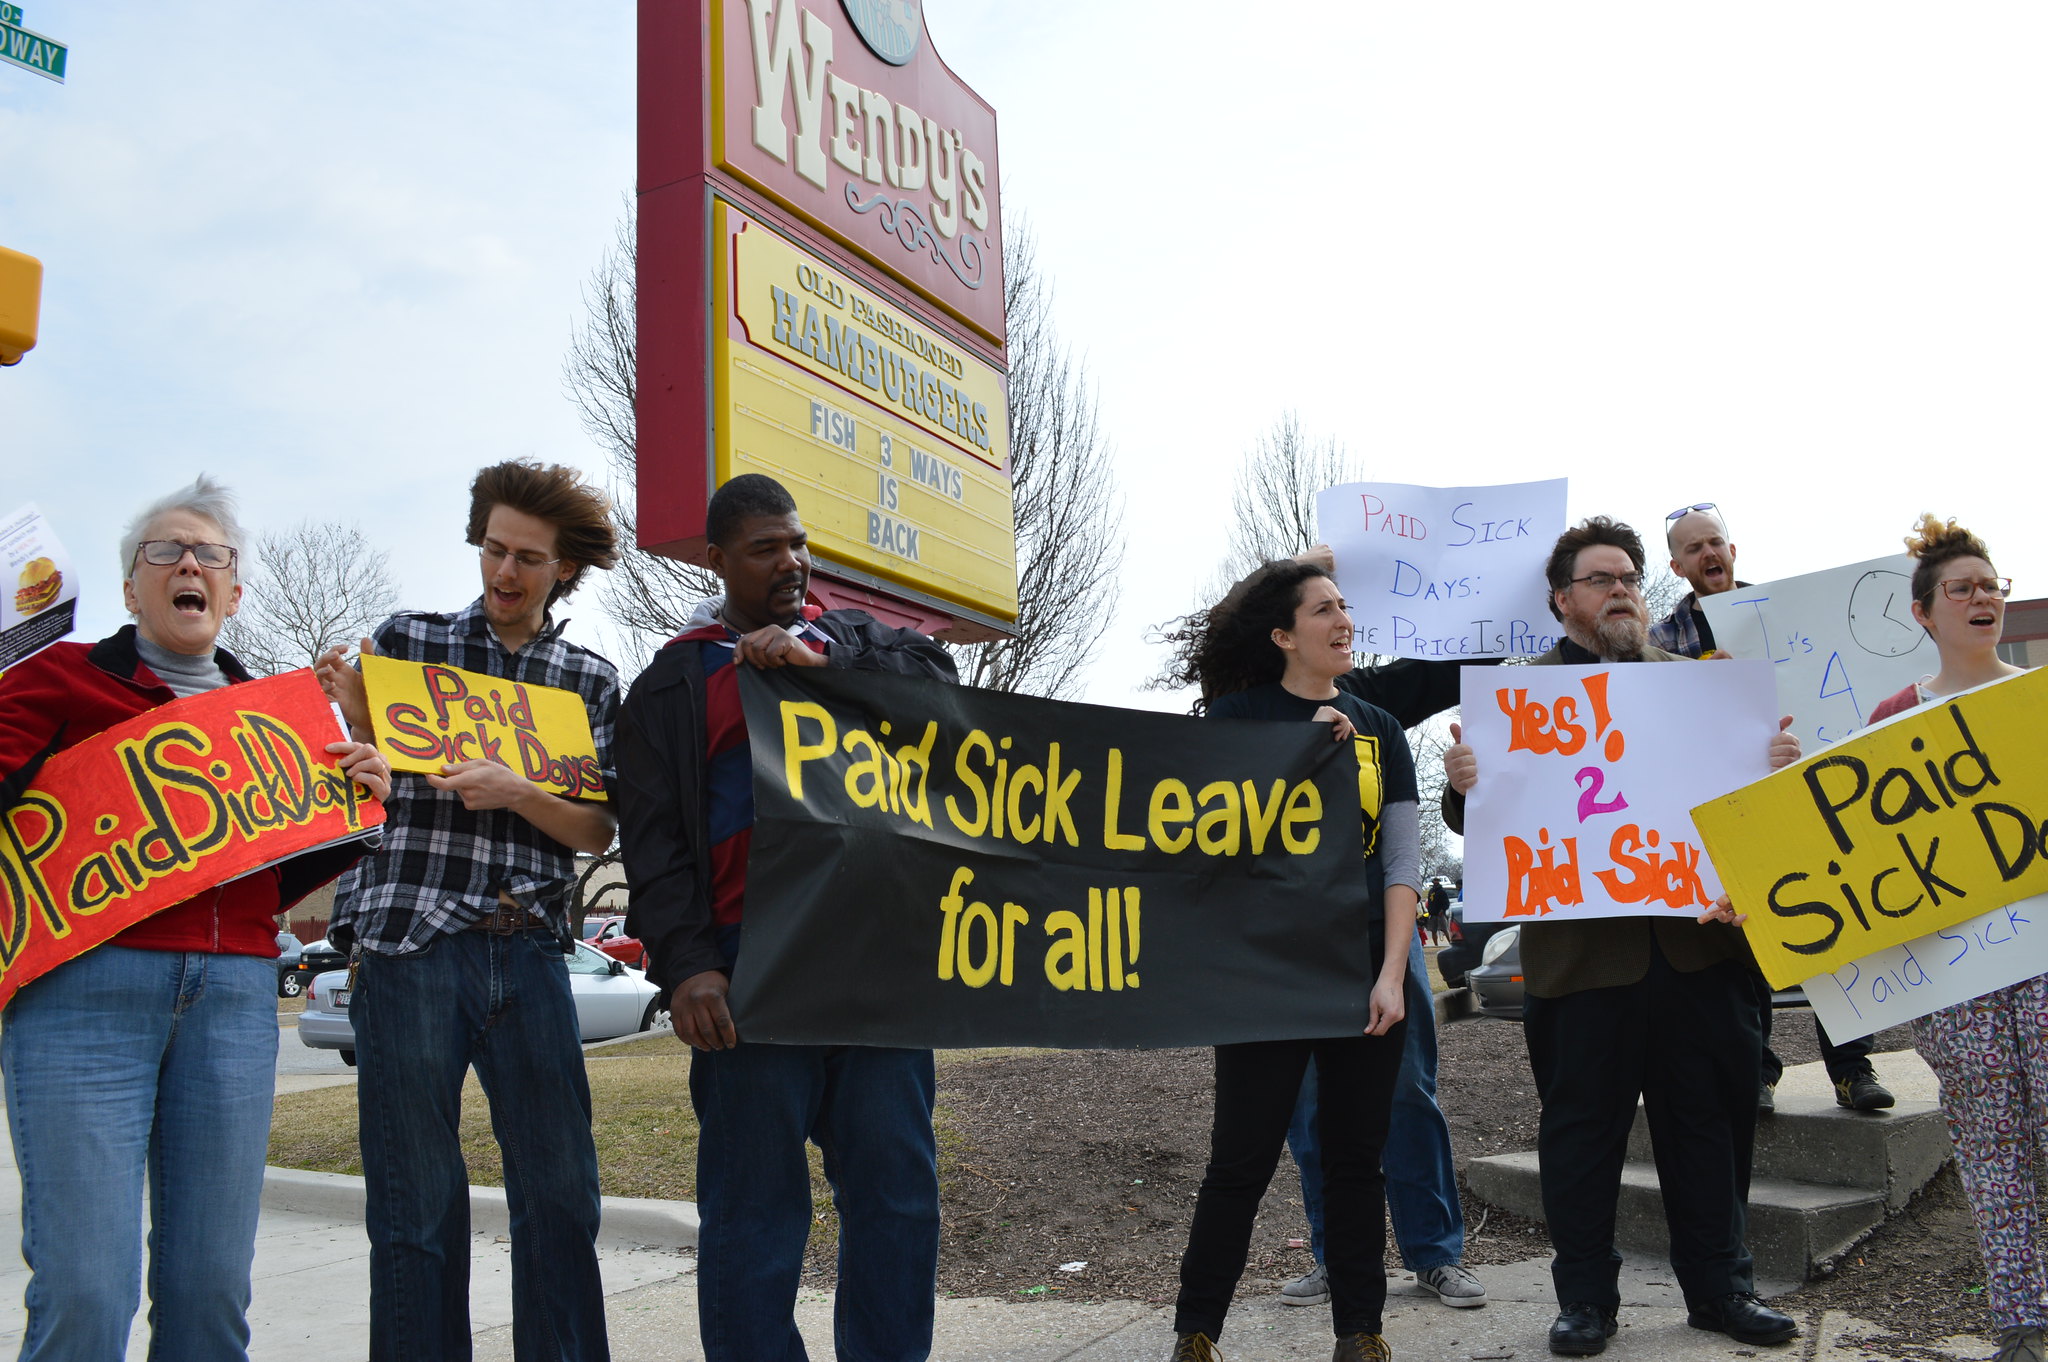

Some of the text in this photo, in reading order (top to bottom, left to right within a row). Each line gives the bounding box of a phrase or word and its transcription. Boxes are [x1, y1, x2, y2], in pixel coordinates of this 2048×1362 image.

[796, 262, 965, 381] OLD FASHIONED
[811, 402, 962, 501] FISH 3 WAYS
[879, 474, 898, 511] IS
[868, 511, 919, 561] BACK
[385, 702, 605, 797] Sick Days
[422, 665, 537, 732] Paid
[1495, 671, 1625, 763] Yes!
[779, 700, 1324, 856] Paid Sick Leave
[1574, 766, 1629, 824] 2
[1803, 704, 2001, 855] Paid
[3, 743, 196, 938] Paid
[1767, 832, 1966, 955] Sick
[938, 866, 1141, 992] for all!
[1832, 905, 2031, 1020] Paid Sick
